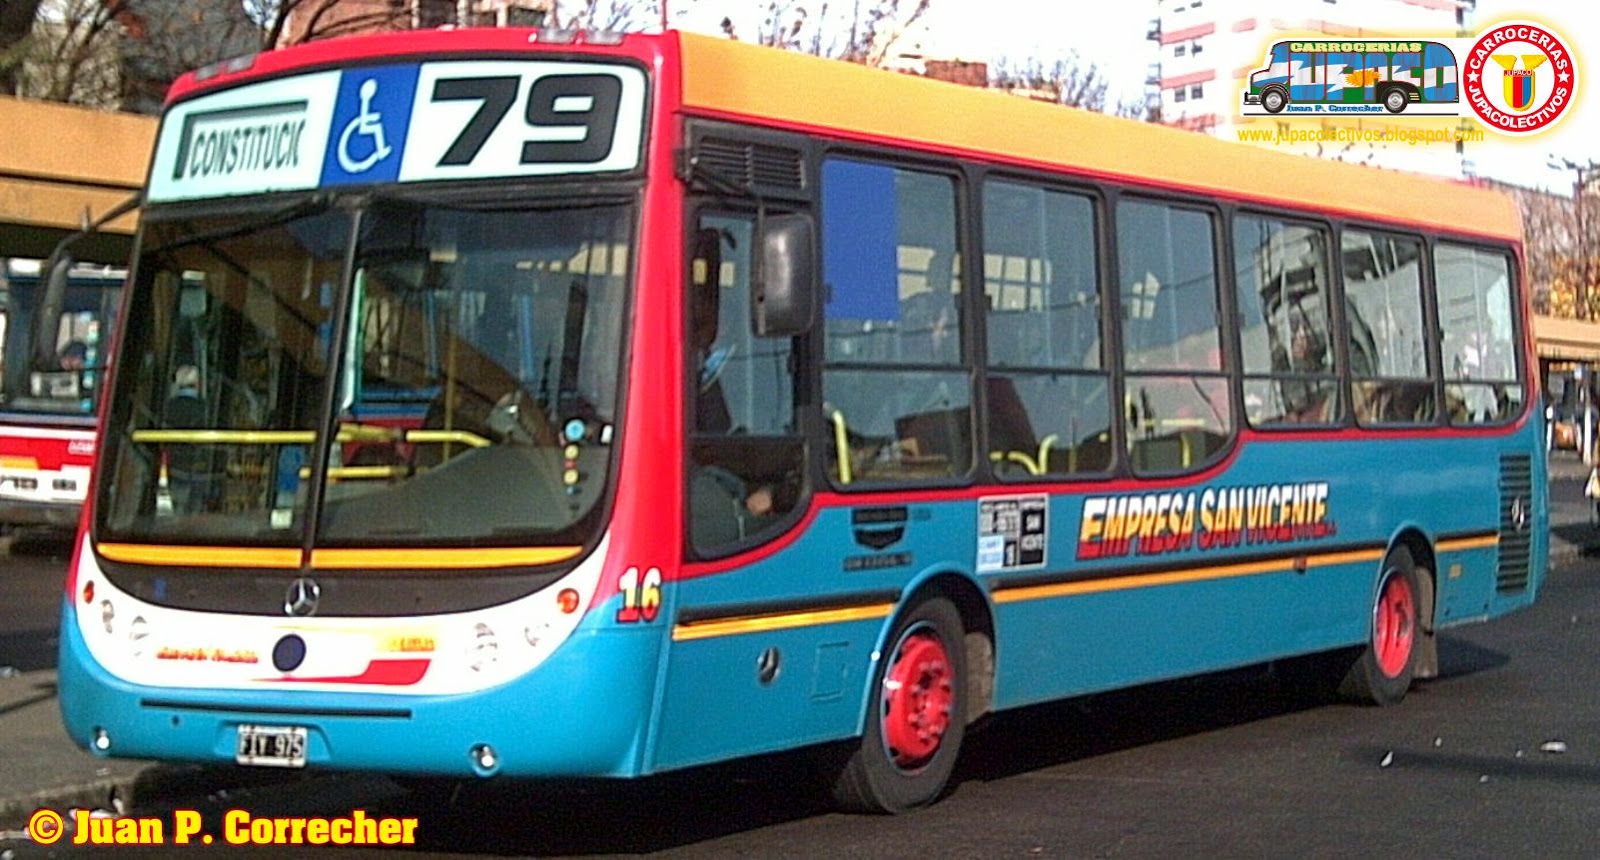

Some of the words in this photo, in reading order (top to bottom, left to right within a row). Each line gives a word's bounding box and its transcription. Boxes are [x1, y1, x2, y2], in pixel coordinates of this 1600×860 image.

[430, 73, 623, 168] 79
[1075, 492, 1195, 560] EMPRESA
[1199, 485, 1244, 548] SAN
[1246, 483, 1329, 542] VICENTE
[615, 566, 662, 623] 16
